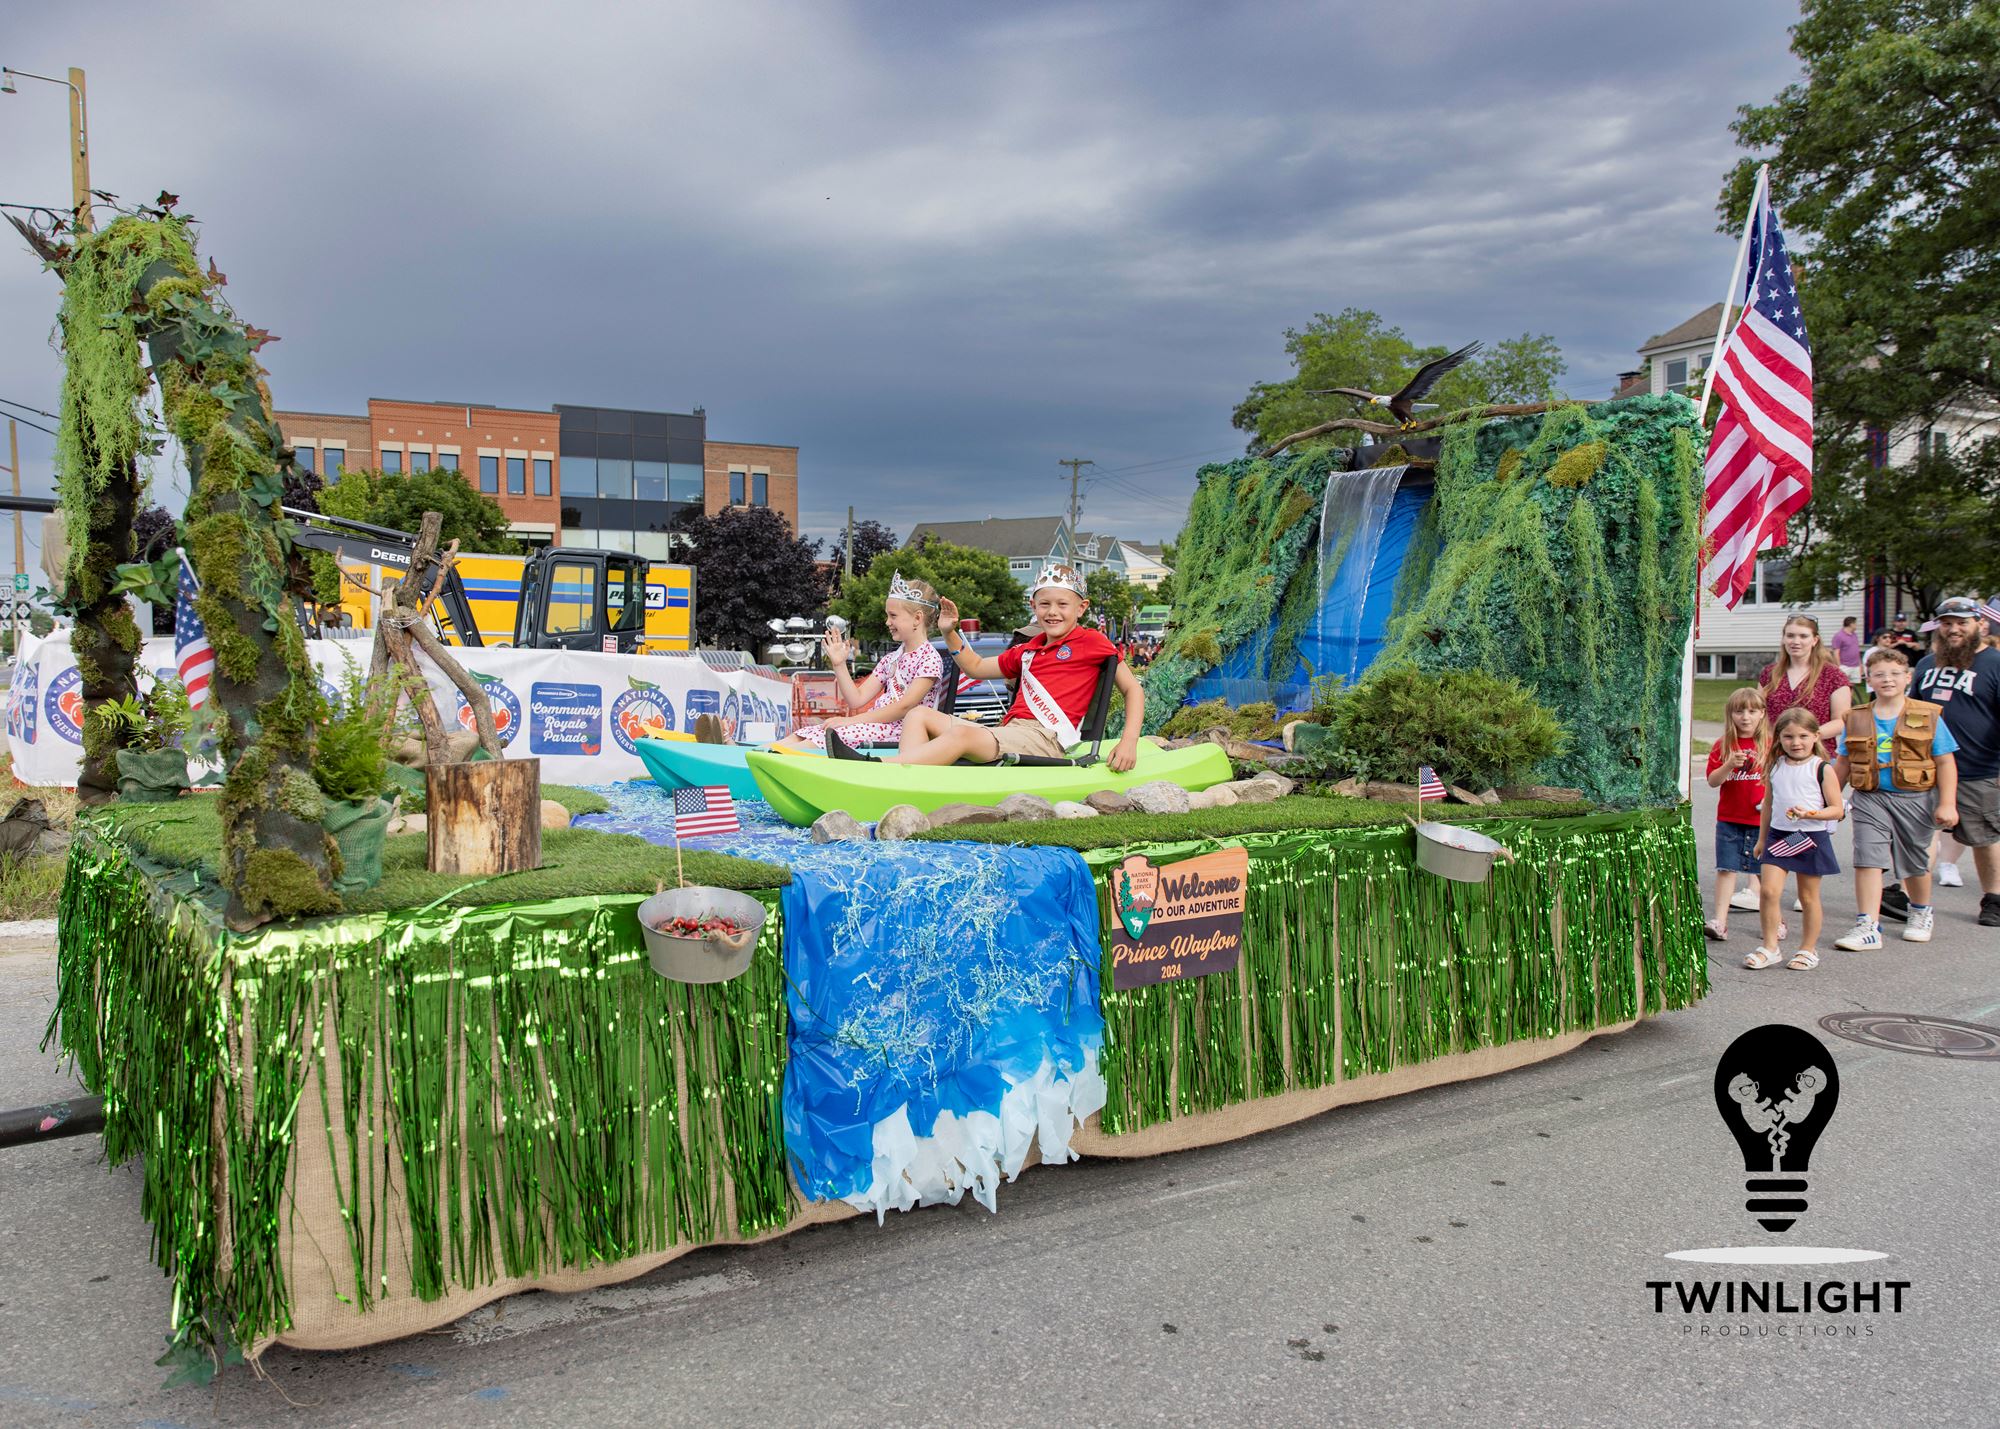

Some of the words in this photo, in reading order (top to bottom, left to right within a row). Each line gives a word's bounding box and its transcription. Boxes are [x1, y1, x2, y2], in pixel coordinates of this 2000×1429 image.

[371, 548, 411, 564] DEERE
[608, 590, 662, 601] PEKE
[1920, 666, 1977, 696] USA
[457, 684, 514, 703] NONAL
[618, 690, 668, 710] NATIONAL
[531, 702, 602, 719] Community
[1032, 694, 1059, 725] WAYLON
[544, 716, 588, 732] Royale
[543, 729, 588, 743] Parade
[1161, 872, 1241, 903] Welcome
[1152, 907, 1163, 919] TO
[1166, 904, 1186, 916] OUR
[1188, 898, 1240, 914] ADVENTURE
[1112, 942, 1168, 968] Prince
[1170, 929, 1238, 960] Waylon
[1161, 964, 1182, 979] 2024
